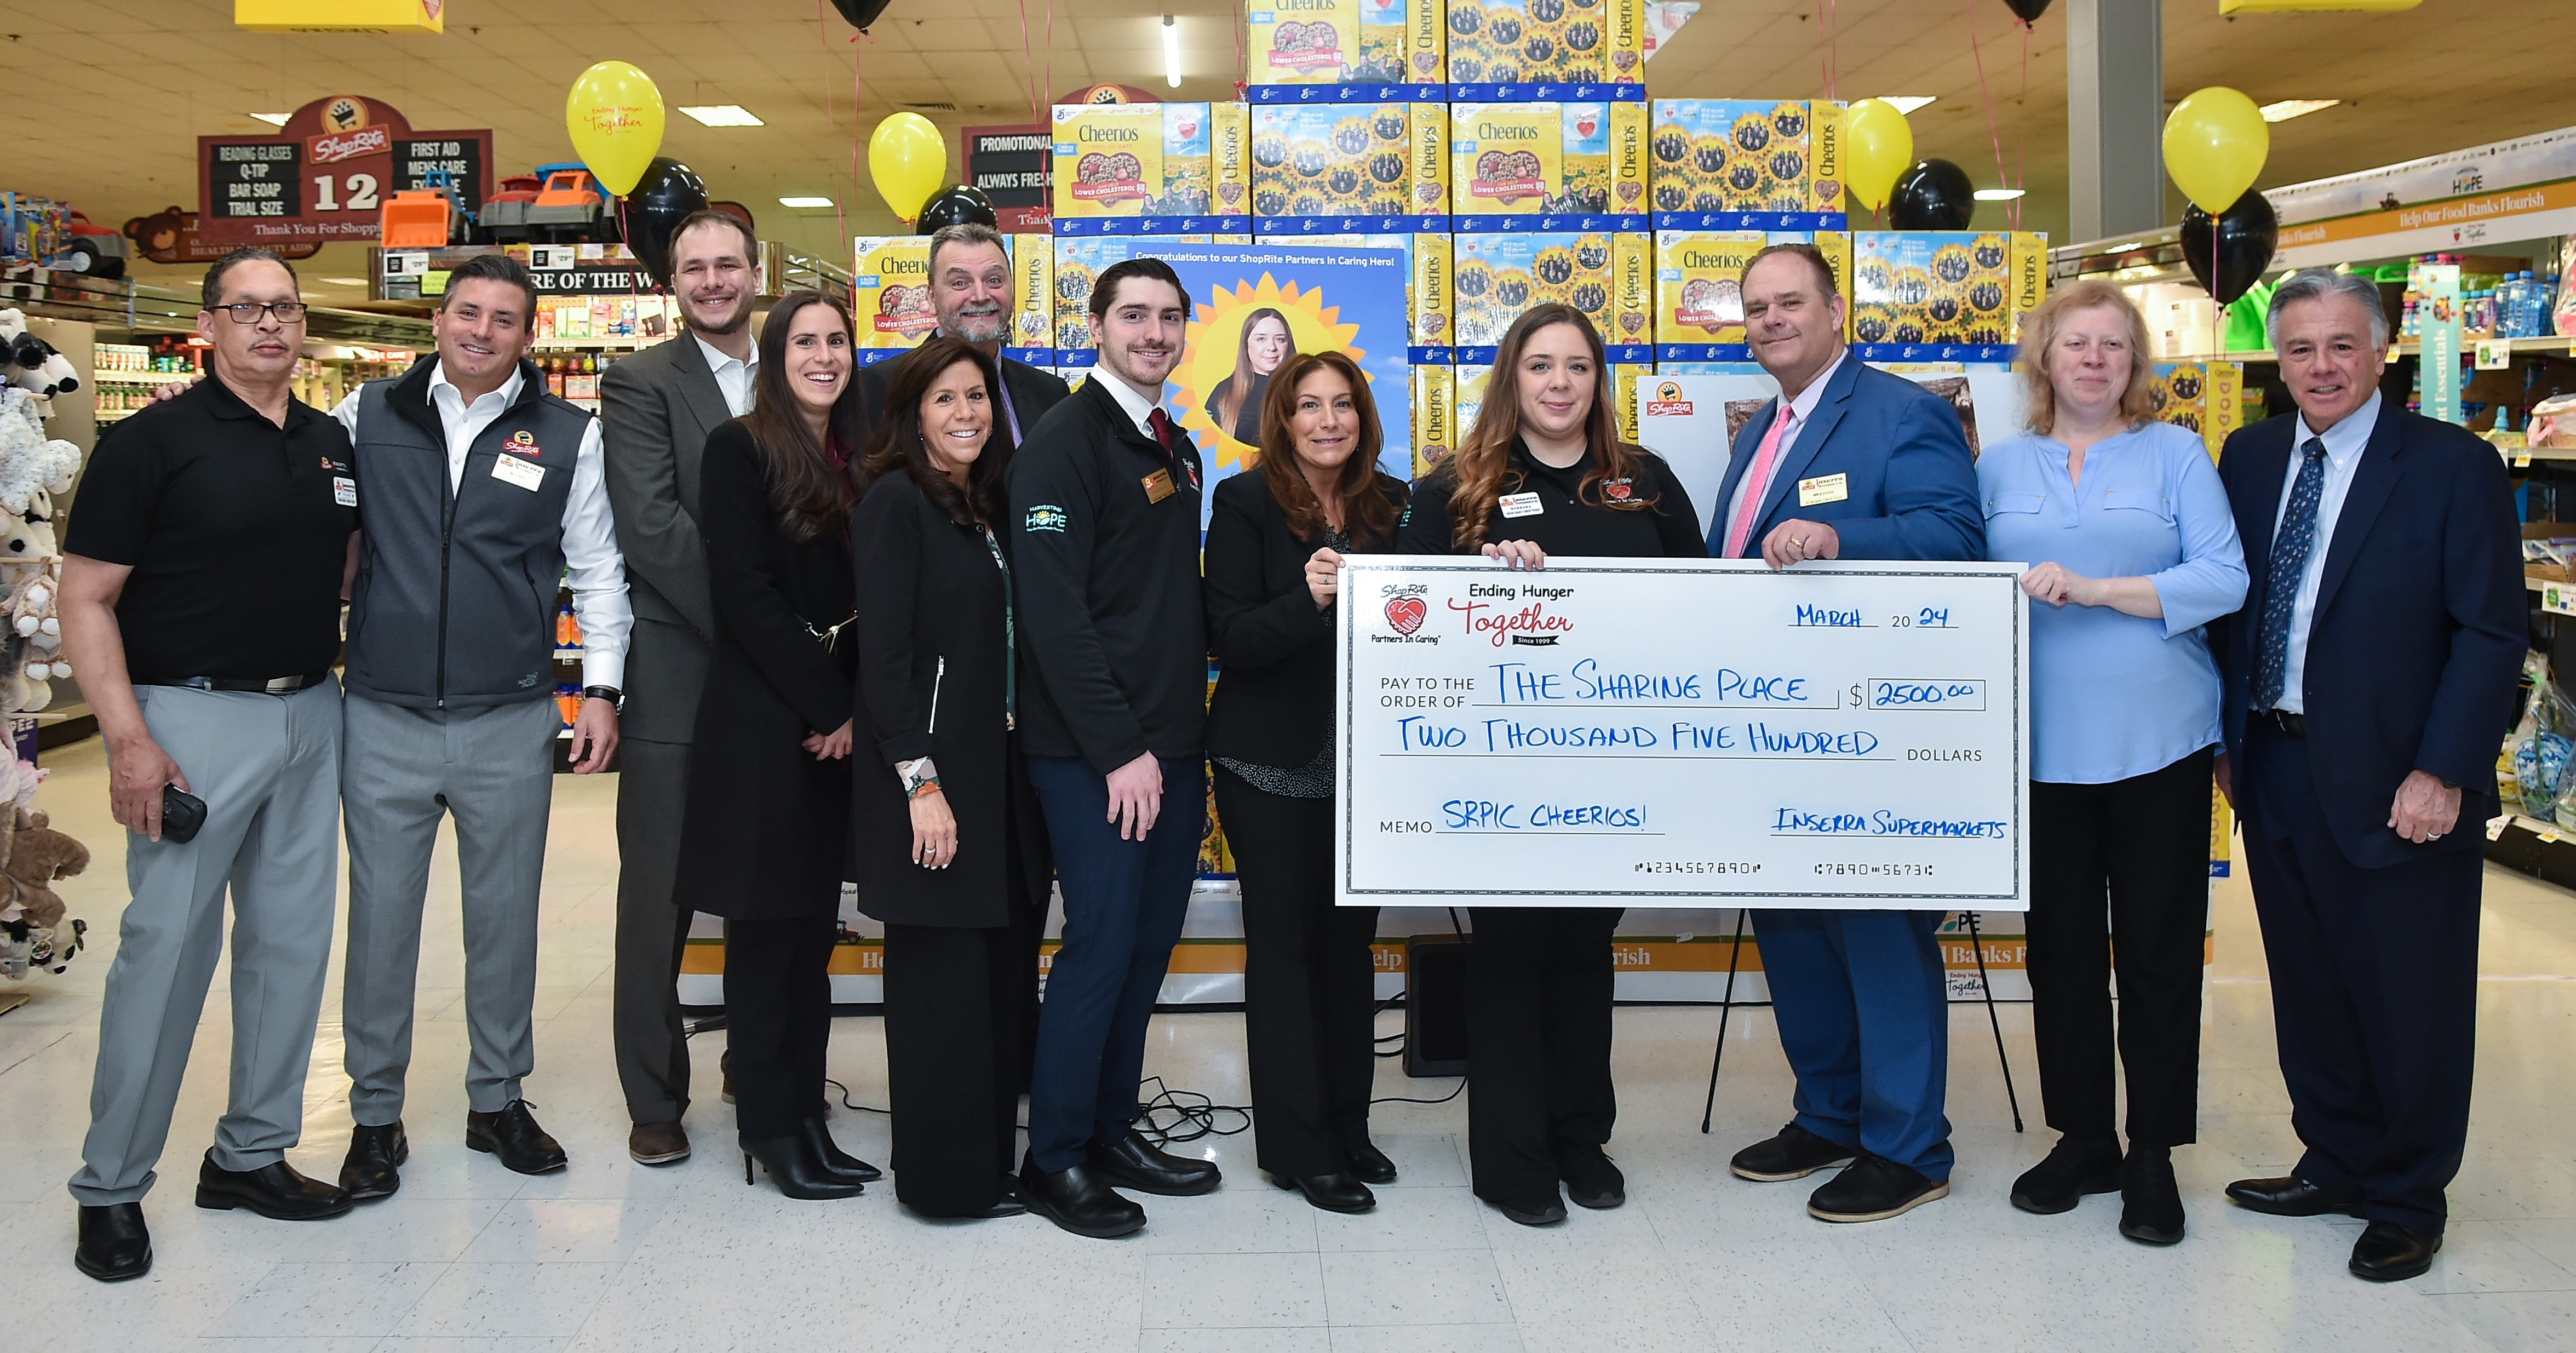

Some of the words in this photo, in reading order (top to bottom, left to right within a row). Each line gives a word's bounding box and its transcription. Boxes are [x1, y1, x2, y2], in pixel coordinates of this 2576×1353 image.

[1293, 54, 1332, 63] CHOLESTEROL
[584, 114, 643, 135] Together
[1479, 123, 1538, 140] Cheerios
[1079, 125, 1139, 142] Cheerios
[315, 130, 387, 160] ShopRite
[411, 142, 440, 157] FIRST
[442, 142, 460, 156] AID
[980, 135, 1053, 152] PROMOTIONAL
[1622, 125, 1637, 179] Cheerios
[1820, 125, 1835, 177] Cheerios
[220, 146, 256, 161] READING
[257, 146, 292, 160] GLASSES
[1223, 126, 1238, 179] Cheerios
[240, 163, 269, 180] Q-TIP
[439, 160, 467, 175] CARE
[978, 173, 1018, 188] ALWAYS
[1021, 172, 1053, 187] FRESH
[1495, 184, 1535, 192] CHOLESTEROL
[229, 184, 251, 198] BAR
[253, 182, 281, 197] SOAP
[314, 173, 380, 210] 12
[1095, 186, 1135, 195] CHOLESTEROL
[228, 202, 259, 216] TRIAL
[260, 201, 284, 215] SIZE
[2400, 210, 2422, 228] Help
[2423, 210, 2441, 223] Our
[2442, 203, 2466, 220] Food
[2469, 199, 2499, 216] Banks
[2500, 192, 2545, 212] Flourish
[254, 223, 290, 235] Thank
[293, 223, 315, 234] You
[319, 223, 339, 234] For
[341, 222, 382, 236] Shoppi
[1135, 251, 1208, 263] Congratulations
[1210, 254, 1219, 262] to
[1240, 254, 1283, 264] ShopRite
[1286, 255, 1325, 265] Partners
[1327, 256, 1335, 265] In
[1338, 256, 1367, 267] Caring
[1370, 257, 1395, 266] Hero!
[1684, 251, 1743, 268] Cheerios
[560, 273, 587, 289] OF
[589, 273, 631, 288] THE
[633, 272, 654, 288] W
[1025, 259, 1041, 312] Cheerios
[1425, 256, 1441, 309] Cheerios
[1624, 255, 1639, 308] Cheerios
[2020, 255, 2036, 308] Cheerios
[898, 317, 938, 326] CHOLESTEROL
[1427, 388, 1442, 442] Cheerios
[1649, 403, 1691, 416] ShopRite
[1029, 504, 1062, 513] HARVESTING
[1026, 511, 1067, 528] HOPE
[1380, 584, 1428, 599] ShopRite
[1470, 584, 1516, 600] Ending
[1522, 584, 1575, 601] Hunger
[1448, 597, 1574, 647] Together
[1796, 604, 1862, 628] MARCH
[1892, 615, 1911, 628] 20
[1919, 606, 1949, 628] 24
[1372, 634, 1403, 643] Partners
[1381, 678, 1410, 690] PAY
[1415, 678, 1438, 690] TO
[1443, 678, 1476, 690] THE
[1489, 662, 1565, 704] THE
[1571, 658, 1701, 700] SHARING
[1718, 668, 1808, 701] PLACE
[1380, 696, 1437, 708] ORDER
[1443, 696, 1466, 708] OF
[1849, 682, 1862, 710] $
[1875, 682, 1974, 706] 2500.00
[1397, 715, 1467, 752] TWO
[1481, 718, 1658, 753] THOUSAND
[1672, 721, 1736, 751] FIVE
[1748, 721, 1879, 756] HUNDRED
[1907, 749, 1983, 762] DOLLARS
[1442, 800, 1521, 829] SRPIC
[1529, 803, 1647, 832] CHEERIOS!
[1772, 807, 1867, 832] INSERRA
[1872, 809, 2009, 839] SUPERMARKETS
[1380, 821, 1433, 833] MEMO
[1373, 949, 1402, 970] elp
[1613, 948, 1651, 966] rish
[1952, 945, 2012, 963] Banks
